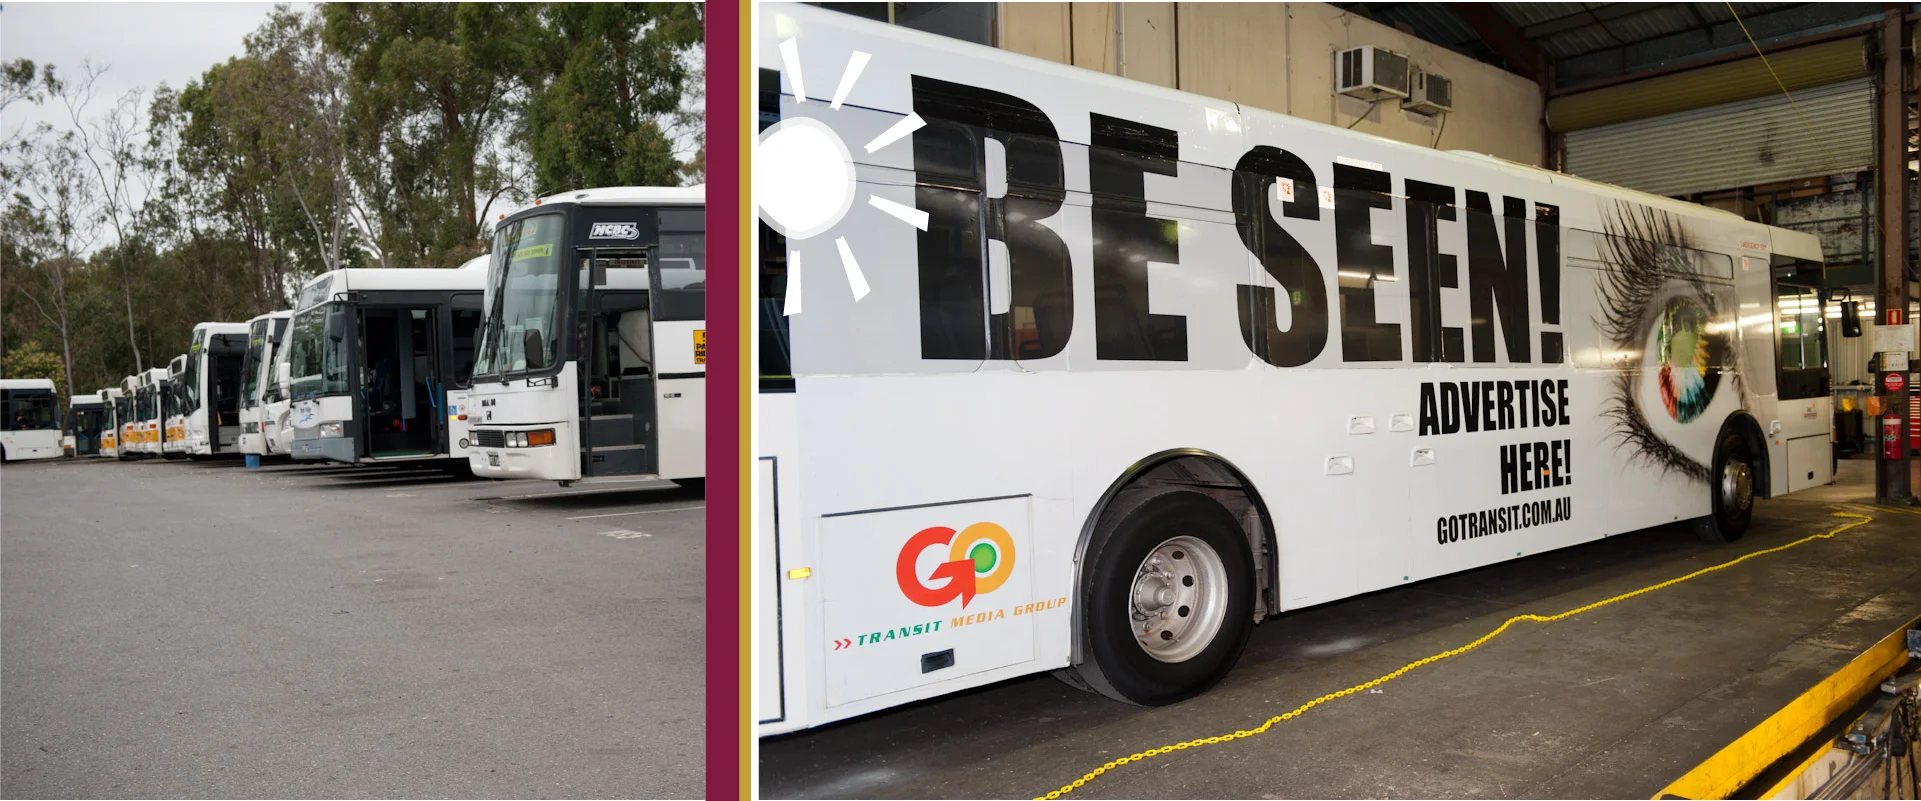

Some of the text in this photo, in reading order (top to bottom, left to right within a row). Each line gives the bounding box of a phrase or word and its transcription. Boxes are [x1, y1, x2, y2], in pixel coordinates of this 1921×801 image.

[911, 74, 1562, 368] BE SEEN!
[1419, 379, 1570, 436] ADVERTISE
[1500, 439, 1571, 495] HERE!
[1437, 497, 1571, 545] GOTRANSIT.COM.AU
[896, 522, 1016, 610] GO
[857, 597, 1067, 646] TRANSIT MEDIA GROUP
